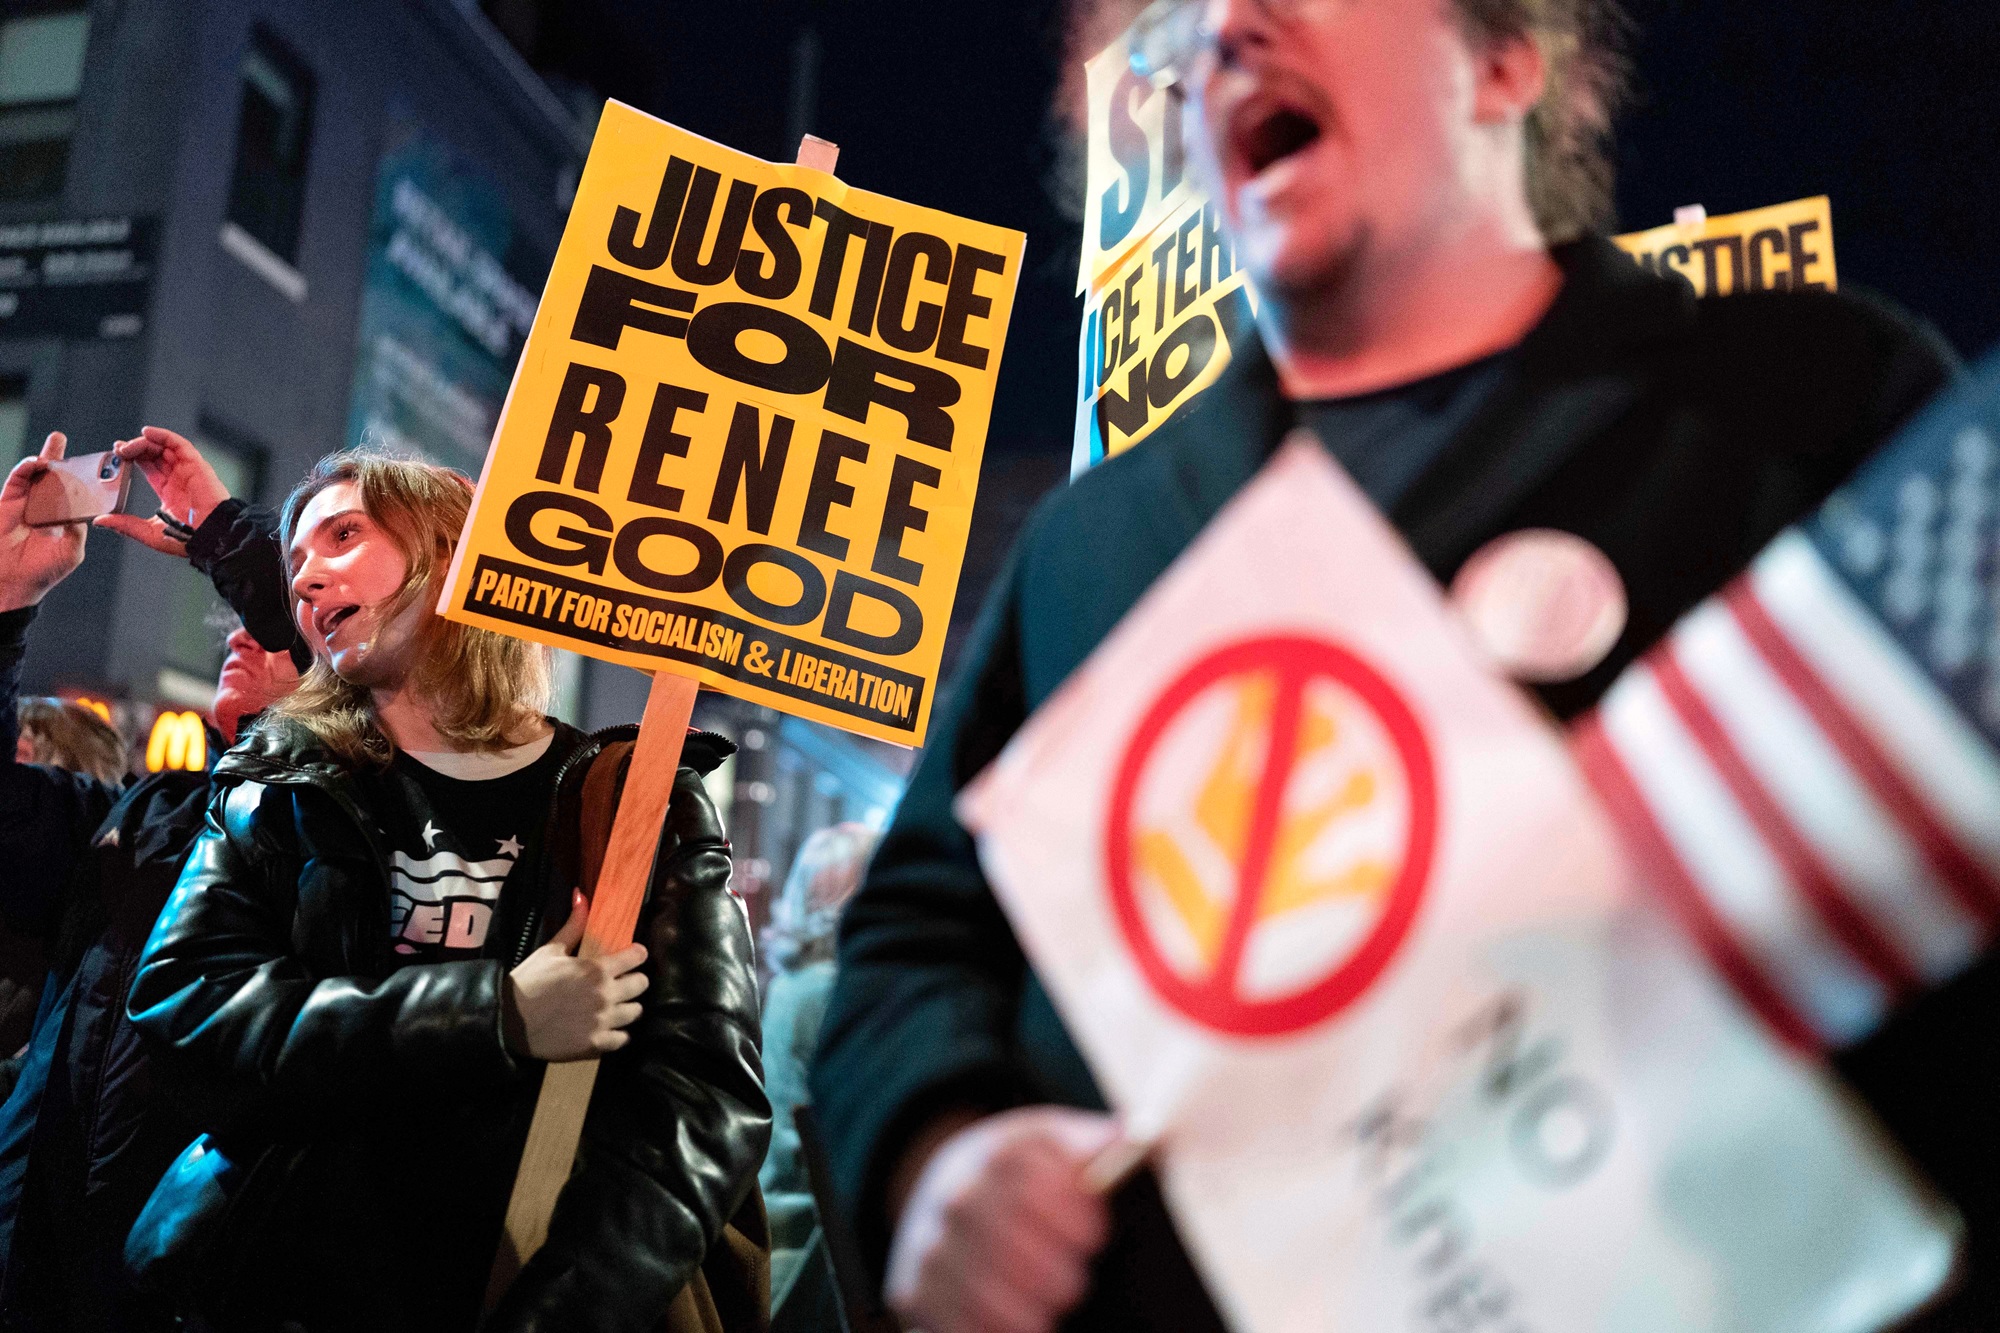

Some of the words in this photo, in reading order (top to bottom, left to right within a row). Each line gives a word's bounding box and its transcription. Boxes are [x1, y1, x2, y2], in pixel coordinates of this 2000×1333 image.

[571, 264, 962, 452] FOR
[607, 155, 1006, 370] JUSTICE
[1084, 262, 1144, 403] ICE
[1152, 200, 1240, 336] TER
[535, 361, 942, 586] RENEE
[474, 568, 562, 619] PARTY
[558, 588, 613, 634] FOR
[611, 603, 745, 666] SOCIALISM
[743, 640, 775, 678] &
[776, 648, 913, 718] LIBERATION
[504, 490, 924, 656] GOOD
